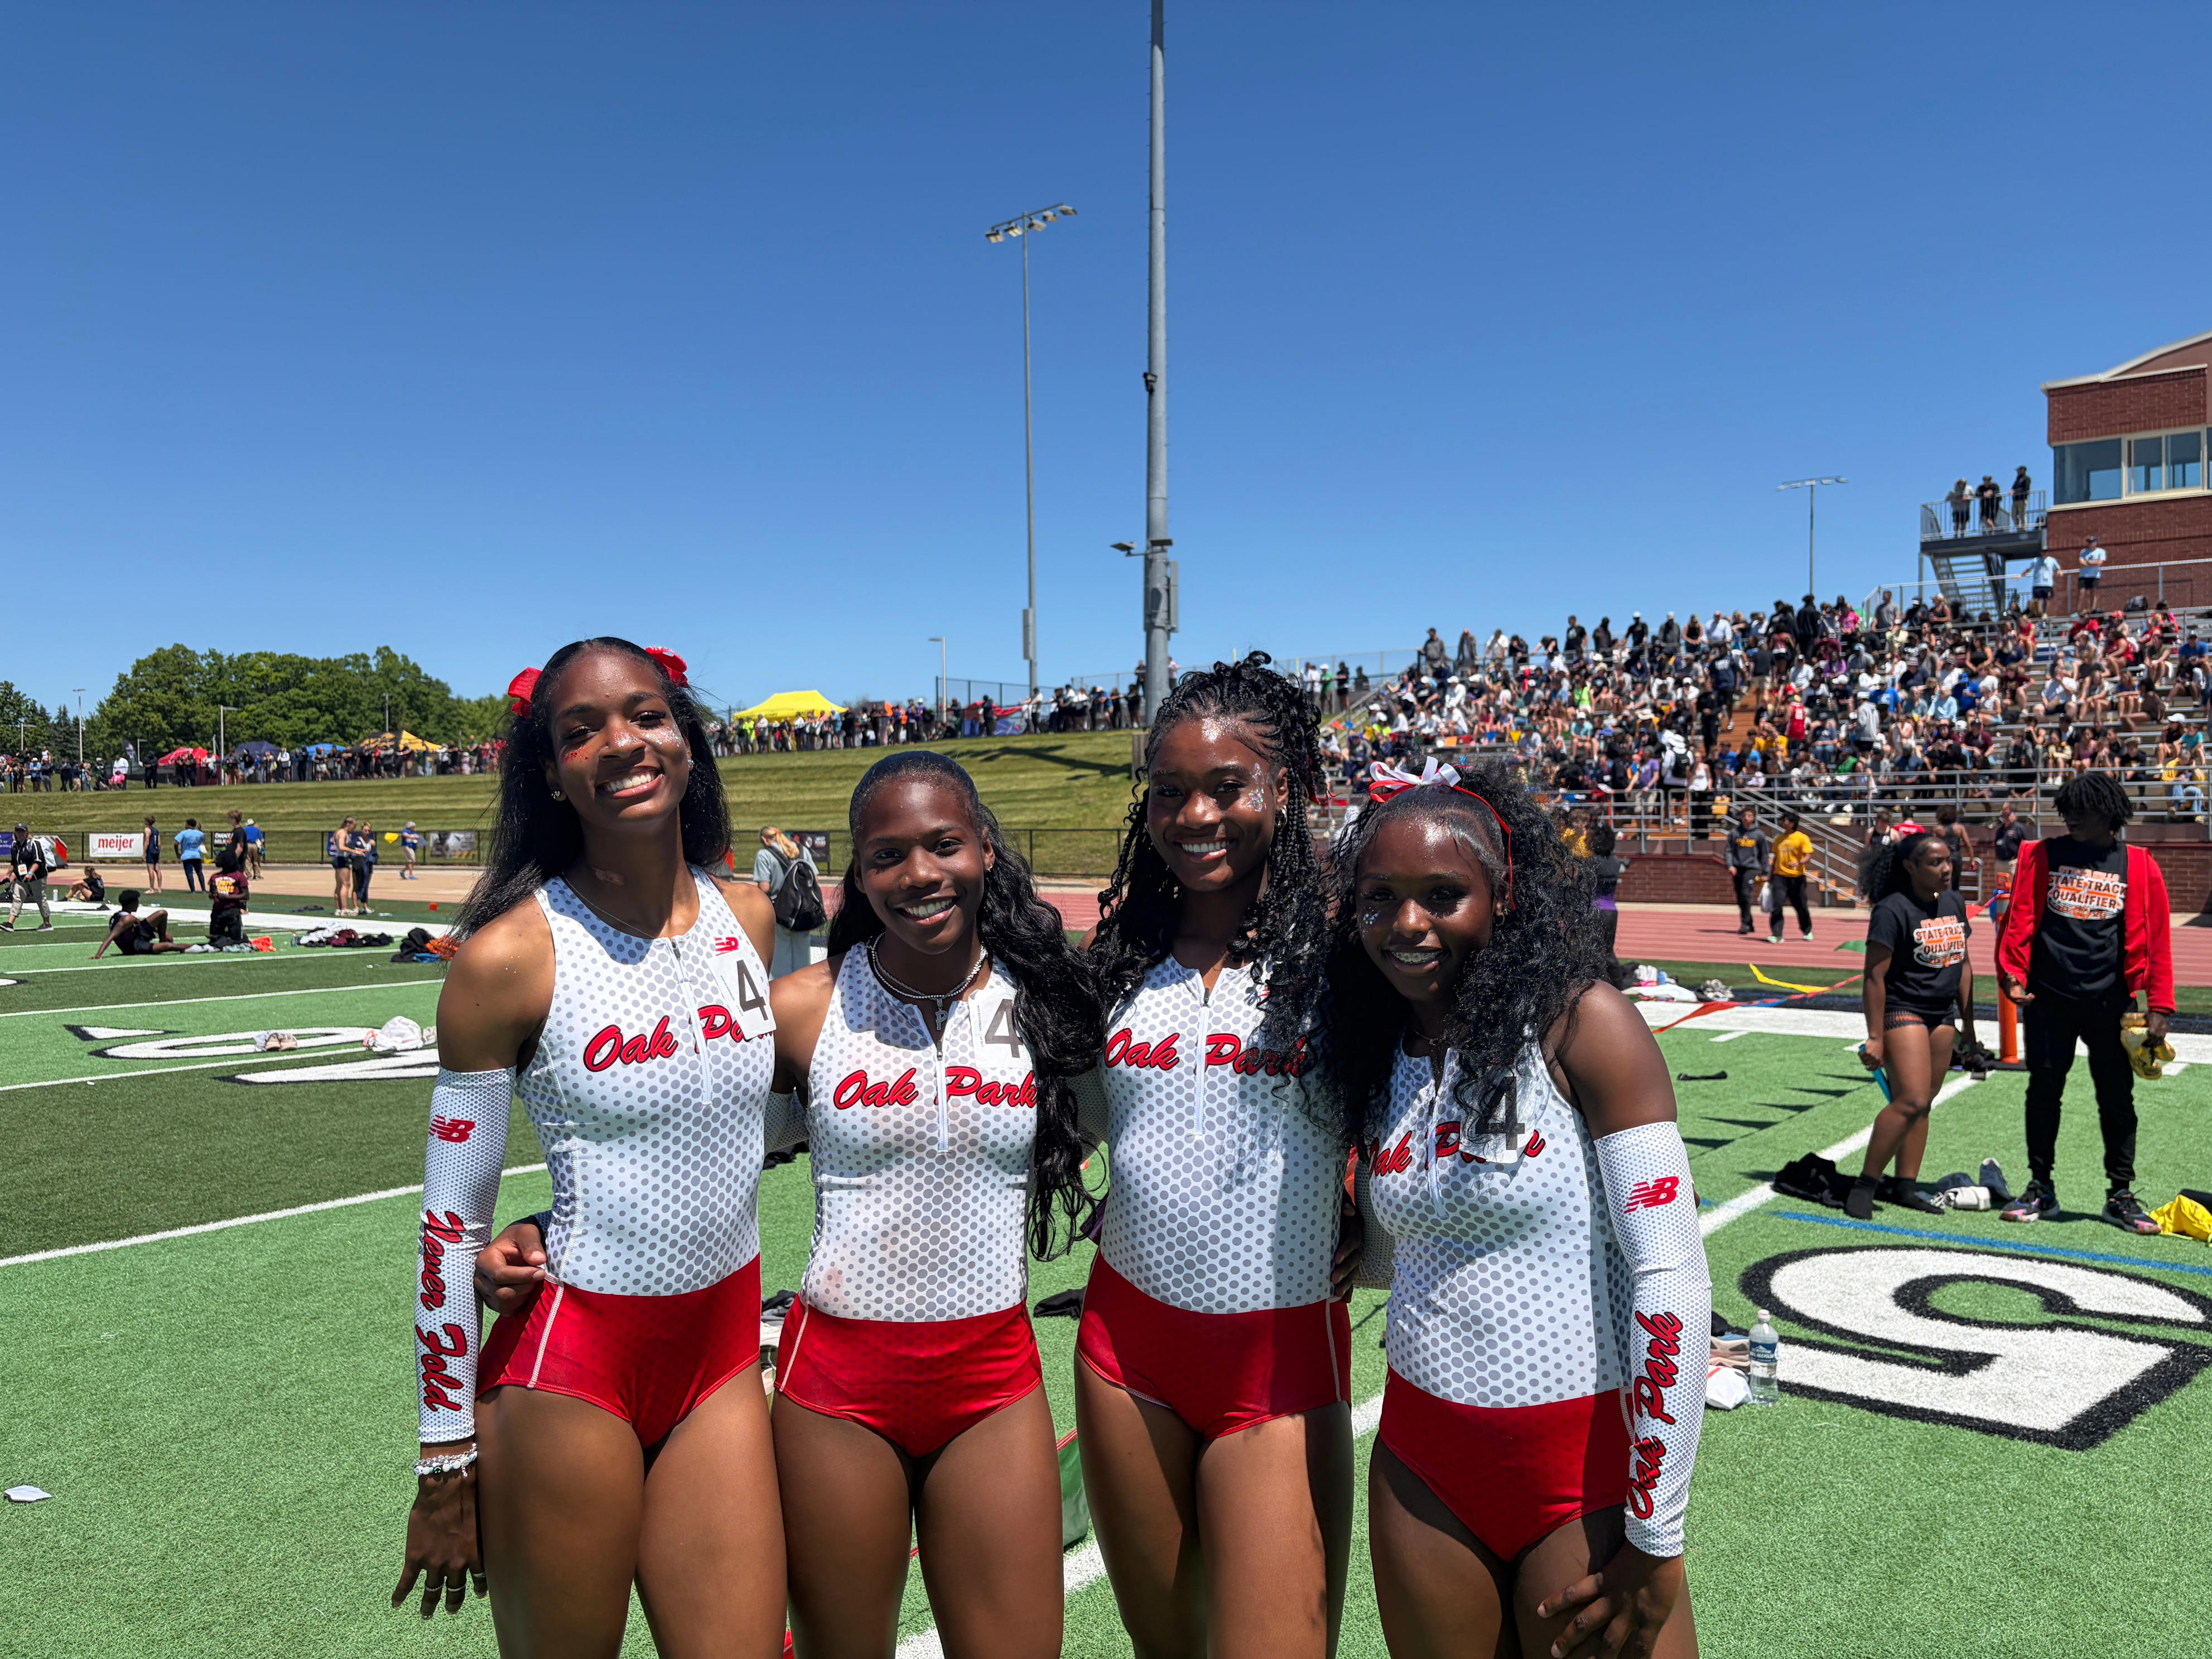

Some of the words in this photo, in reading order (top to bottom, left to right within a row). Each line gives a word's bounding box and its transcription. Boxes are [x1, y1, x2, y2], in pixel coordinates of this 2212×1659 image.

[98, 835, 134, 852] meijer
[2048, 874, 2085, 889] STATE
[2052, 889, 2117, 909] QUALIFIER
[1915, 928, 1944, 941] STATE
[736, 959, 769, 1021] 4
[583, 1015, 679, 1072] Oak
[985, 999, 1024, 1058] 4
[1105, 1028, 1180, 1070] Oak
[833, 1068, 919, 1110] Oak
[933, 1065, 1038, 1108] Park
[1475, 1076, 1525, 1150] 4
[420, 1209, 466, 1311] Never
[415, 1323, 467, 1412] Fold
[1633, 1310, 1684, 1425] Park
[1739, 1245, 2212, 1451] 5
